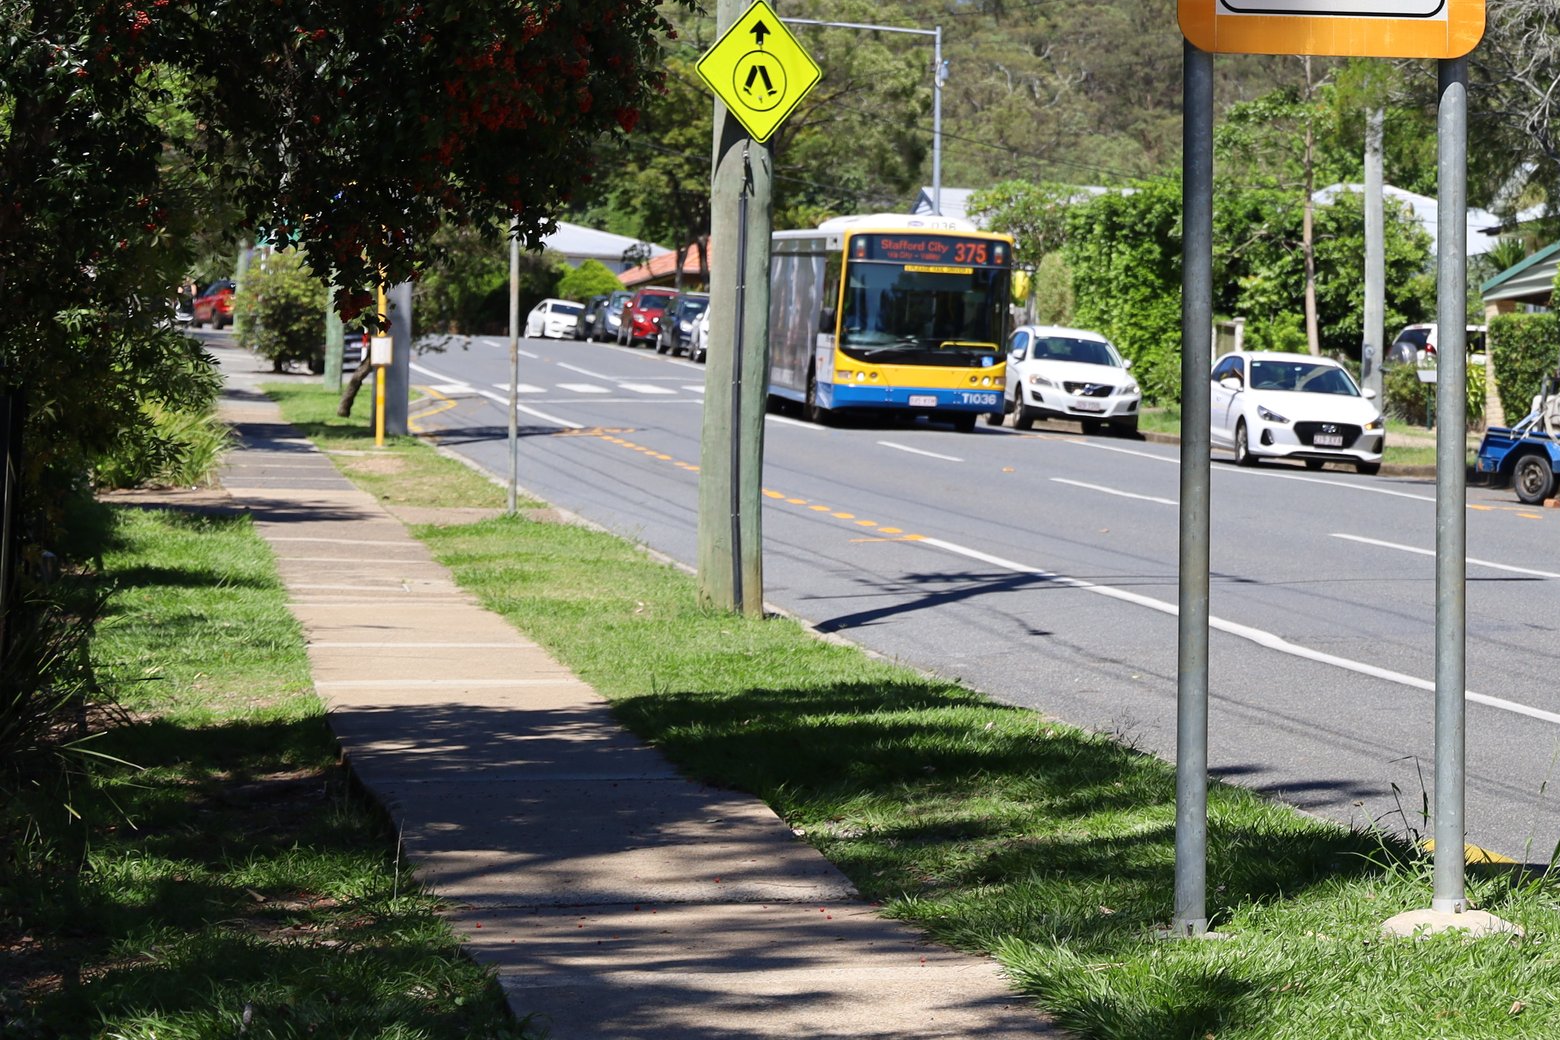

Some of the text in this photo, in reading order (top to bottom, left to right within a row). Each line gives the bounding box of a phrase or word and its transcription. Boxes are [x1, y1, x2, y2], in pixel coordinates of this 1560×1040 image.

[881, 239, 949, 254] Stafford City
[954, 243, 987, 264] 375
